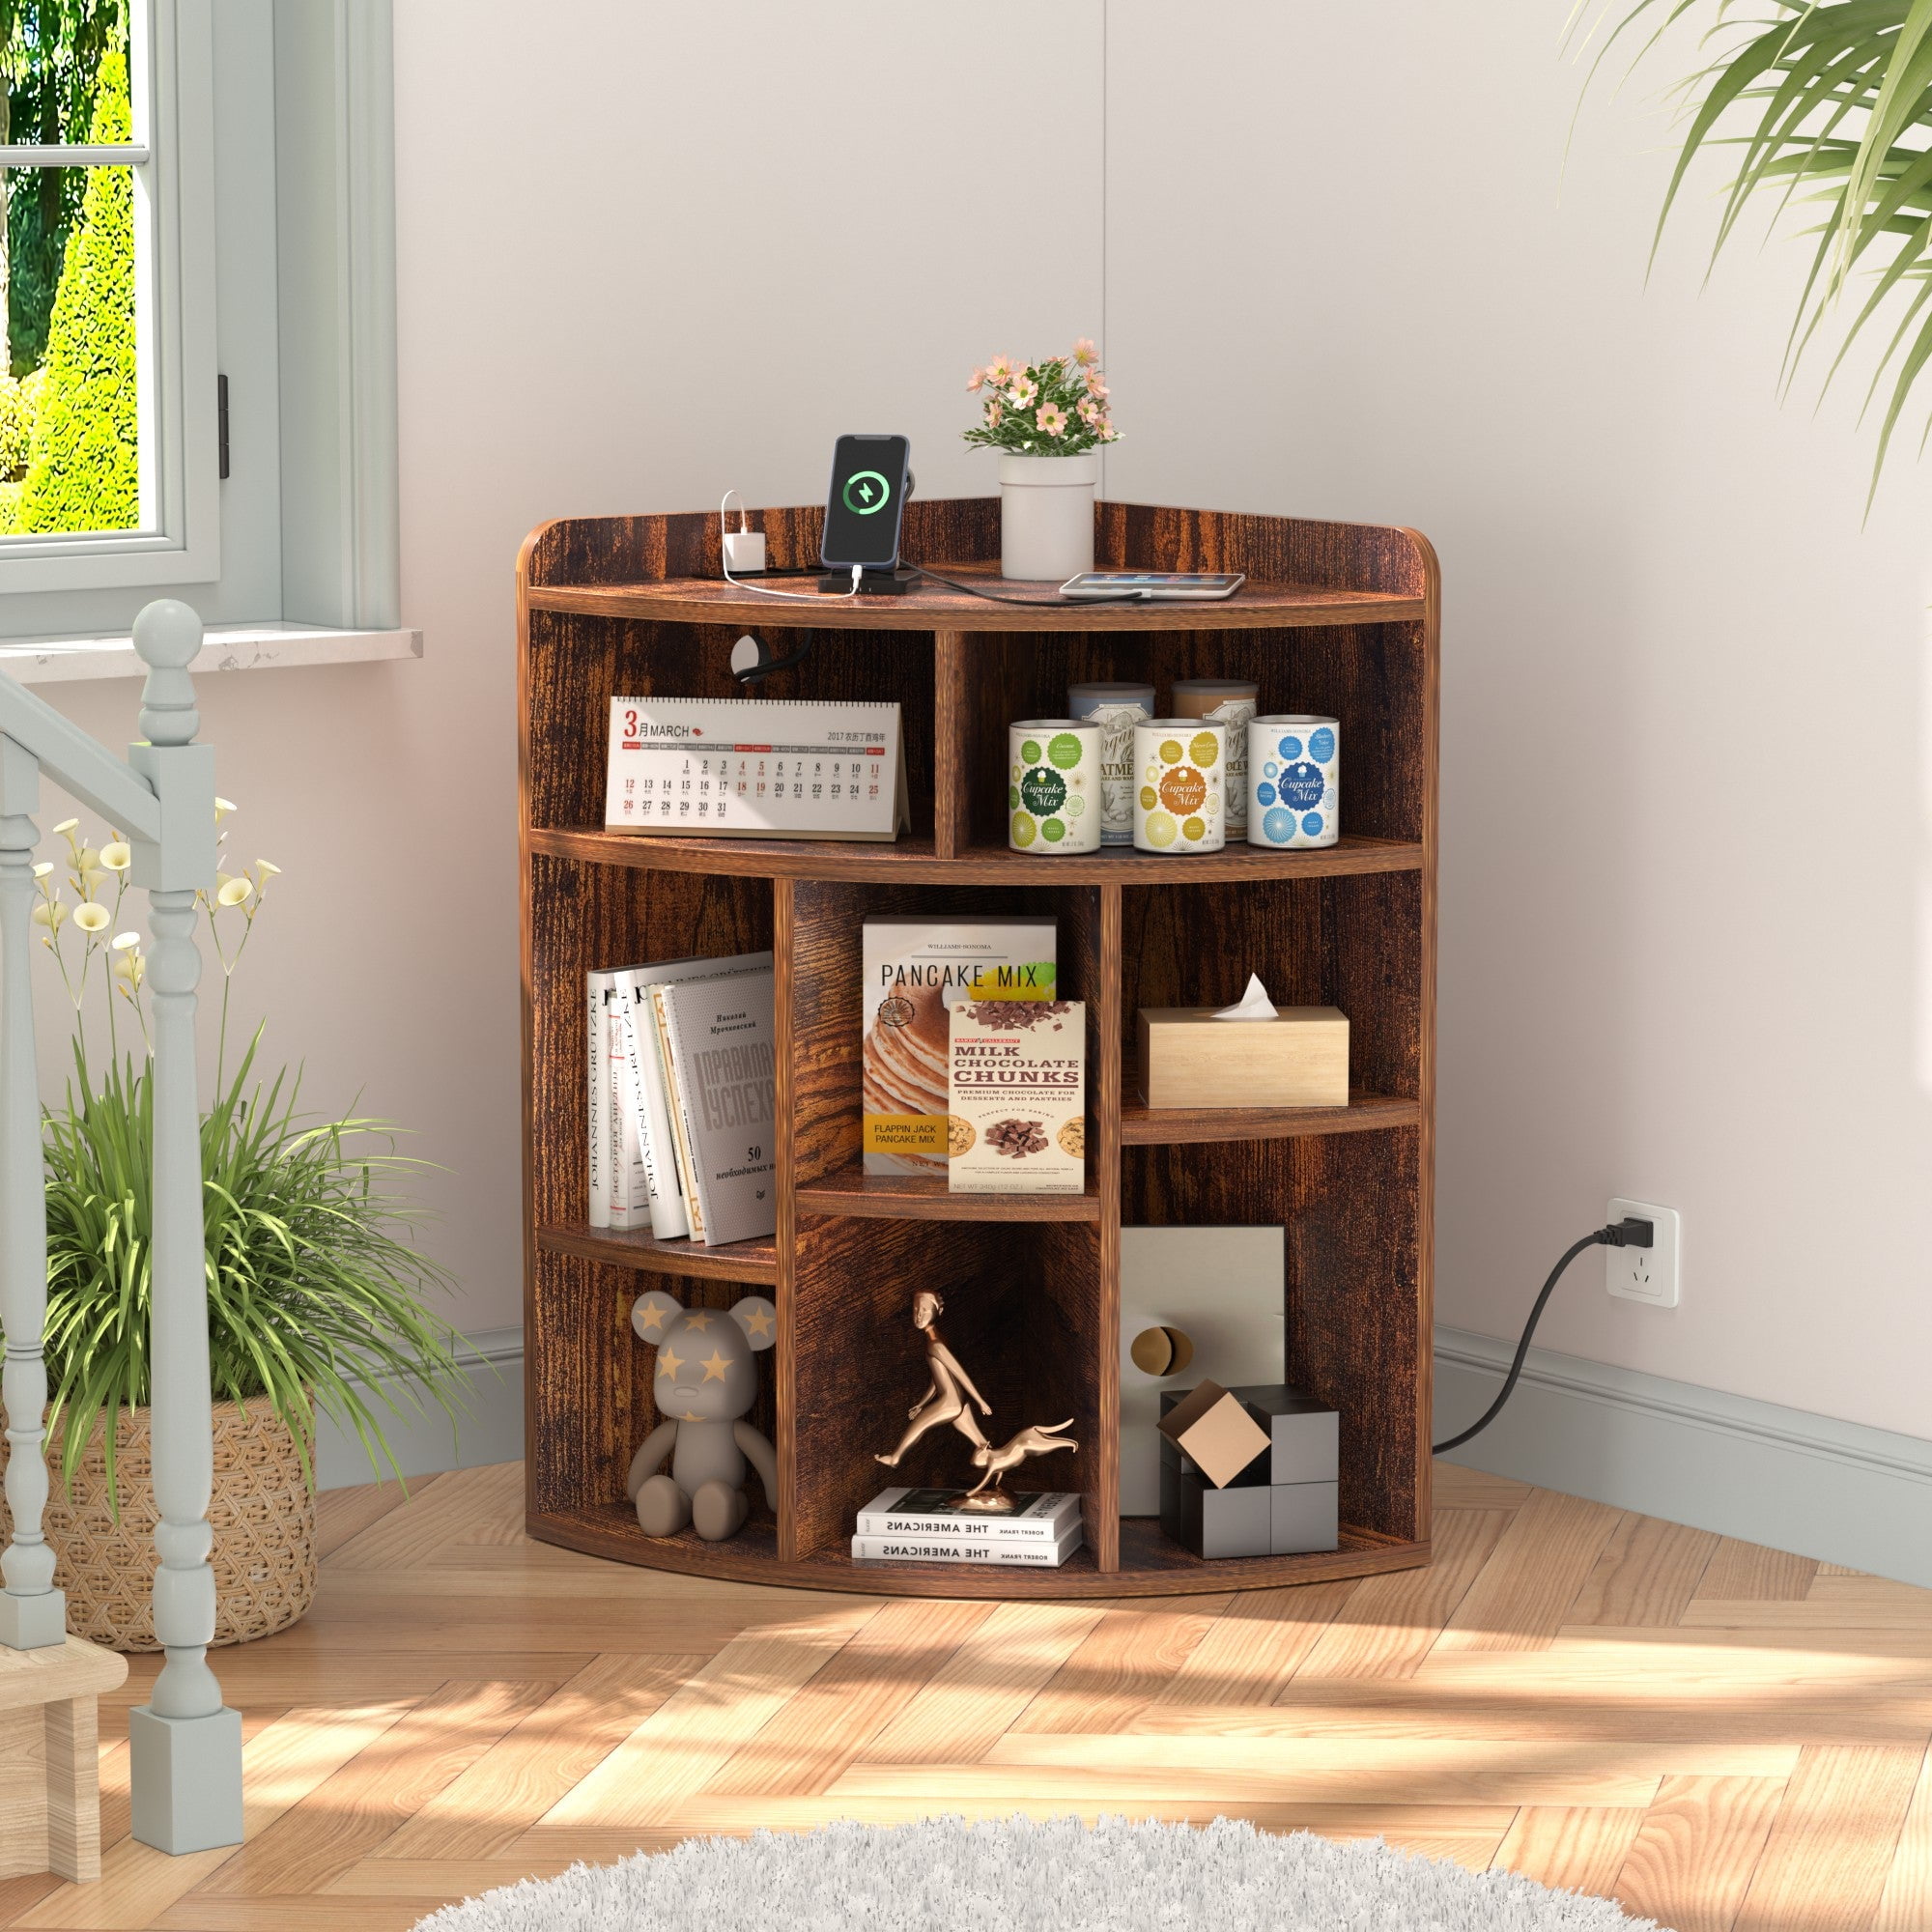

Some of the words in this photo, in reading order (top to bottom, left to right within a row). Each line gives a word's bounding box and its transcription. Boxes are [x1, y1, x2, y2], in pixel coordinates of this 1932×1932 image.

[650, 725, 690, 737] MARCH
[685, 759, 689, 769] 1
[702, 760, 708, 769] 2
[722, 760, 726, 769] 3
[740, 760, 745, 769] 4
[759, 761, 765, 770] 5
[778, 761, 783, 771] 6
[797, 762, 802, 771] 7
[815, 762, 821, 772] 8
[835, 763, 839, 772] 9
[851, 763, 861, 773] 10
[871, 764, 879, 773] 11
[1101, 763, 1134, 775] ATME
[625, 780, 635, 788] 12
[644, 780, 653, 788] 13
[663, 781, 671, 789] 14
[681, 781, 691, 789] 15
[700, 781, 709, 790] 16
[719, 781, 728, 790] 17
[737, 781, 747, 791] 18
[756, 782, 765, 791] 19
[775, 782, 784, 792] 20
[794, 783, 803, 792] 21
[812, 784, 822, 793] 22
[831, 784, 840, 793] 23
[850, 784, 859, 794] 24
[869, 785, 878, 794] 25
[1023, 781, 1063, 795] Cupcake
[1161, 781, 1204, 794] Cupcake
[1281, 777, 1321, 790] Cupcake
[1033, 794, 1059, 807] Mix
[1173, 794, 1200, 806] Mix
[1293, 789, 1318, 802] Mix
[624, 800, 634, 810] 26
[642, 801, 652, 810] 27
[661, 801, 670, 810] 28
[680, 802, 690, 810] 29
[698, 802, 708, 811] 30
[717, 803, 726, 811] 31
[881, 964, 983, 987] PANCAKE
[999, 965, 1037, 987] MIX
[954, 1046, 1020, 1057] MILK
[954, 1059, 1079, 1068] CHOCOLATE
[953, 1070, 1079, 1083] CHUNKS
[748, 1146, 761, 1162] 50
[716, 1164, 768, 1180] необходимых
